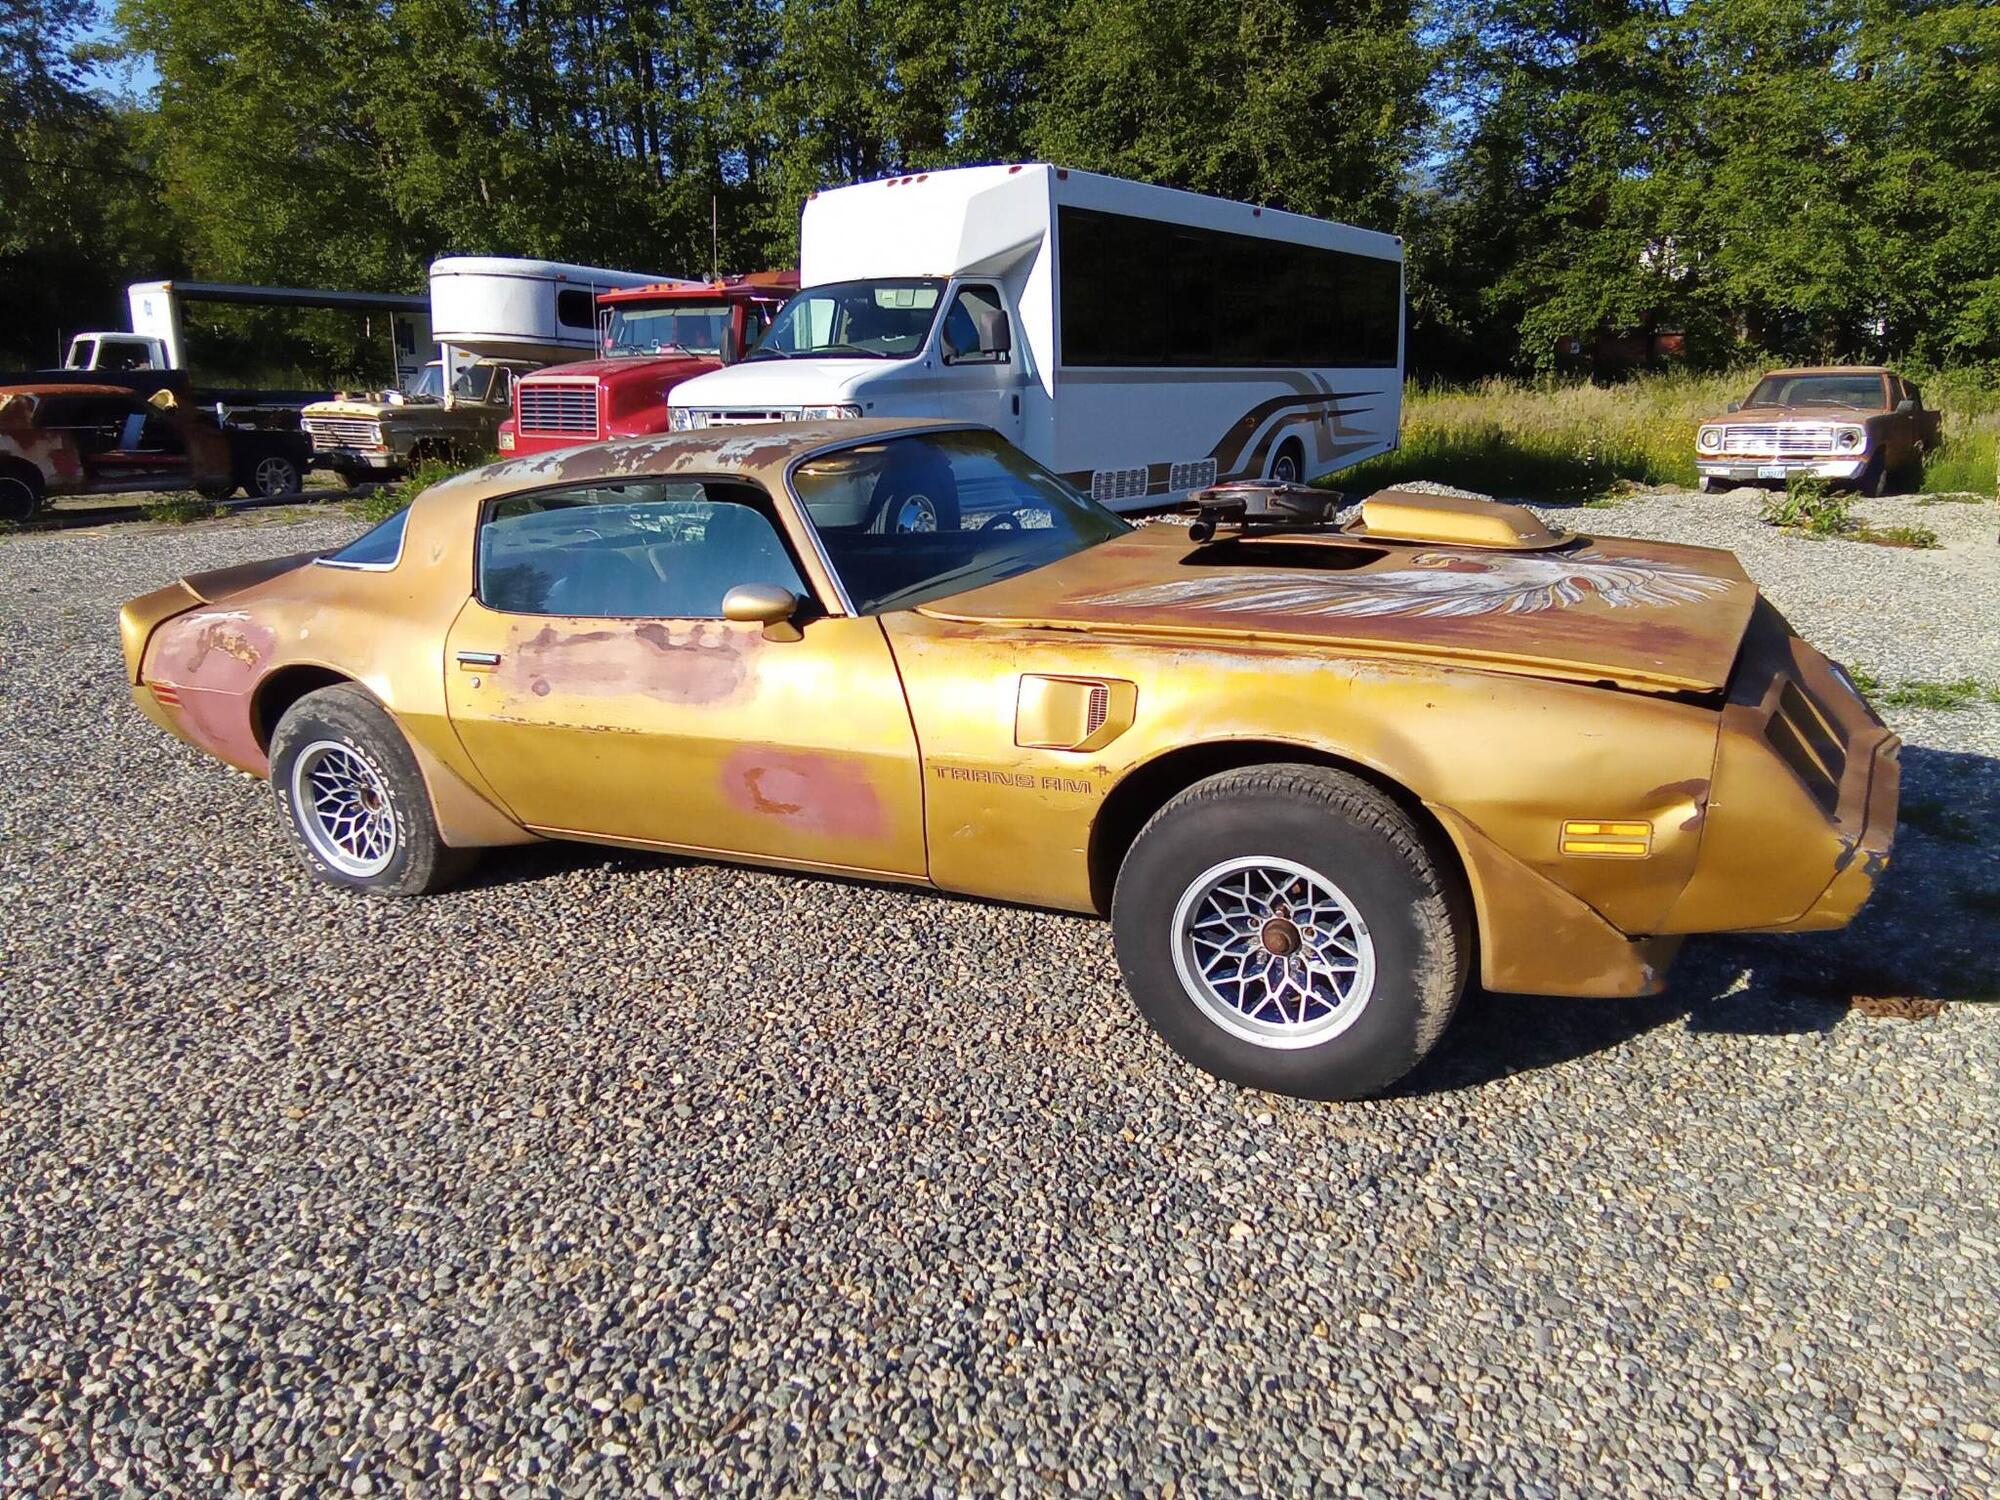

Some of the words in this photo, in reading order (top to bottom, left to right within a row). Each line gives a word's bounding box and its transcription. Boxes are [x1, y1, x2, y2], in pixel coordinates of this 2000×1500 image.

[343, 735, 396, 800] RADIAL
[937, 766, 1034, 788] TRANS
[1041, 776, 1092, 794] AM
[278, 788, 328, 872] DAYTONA
